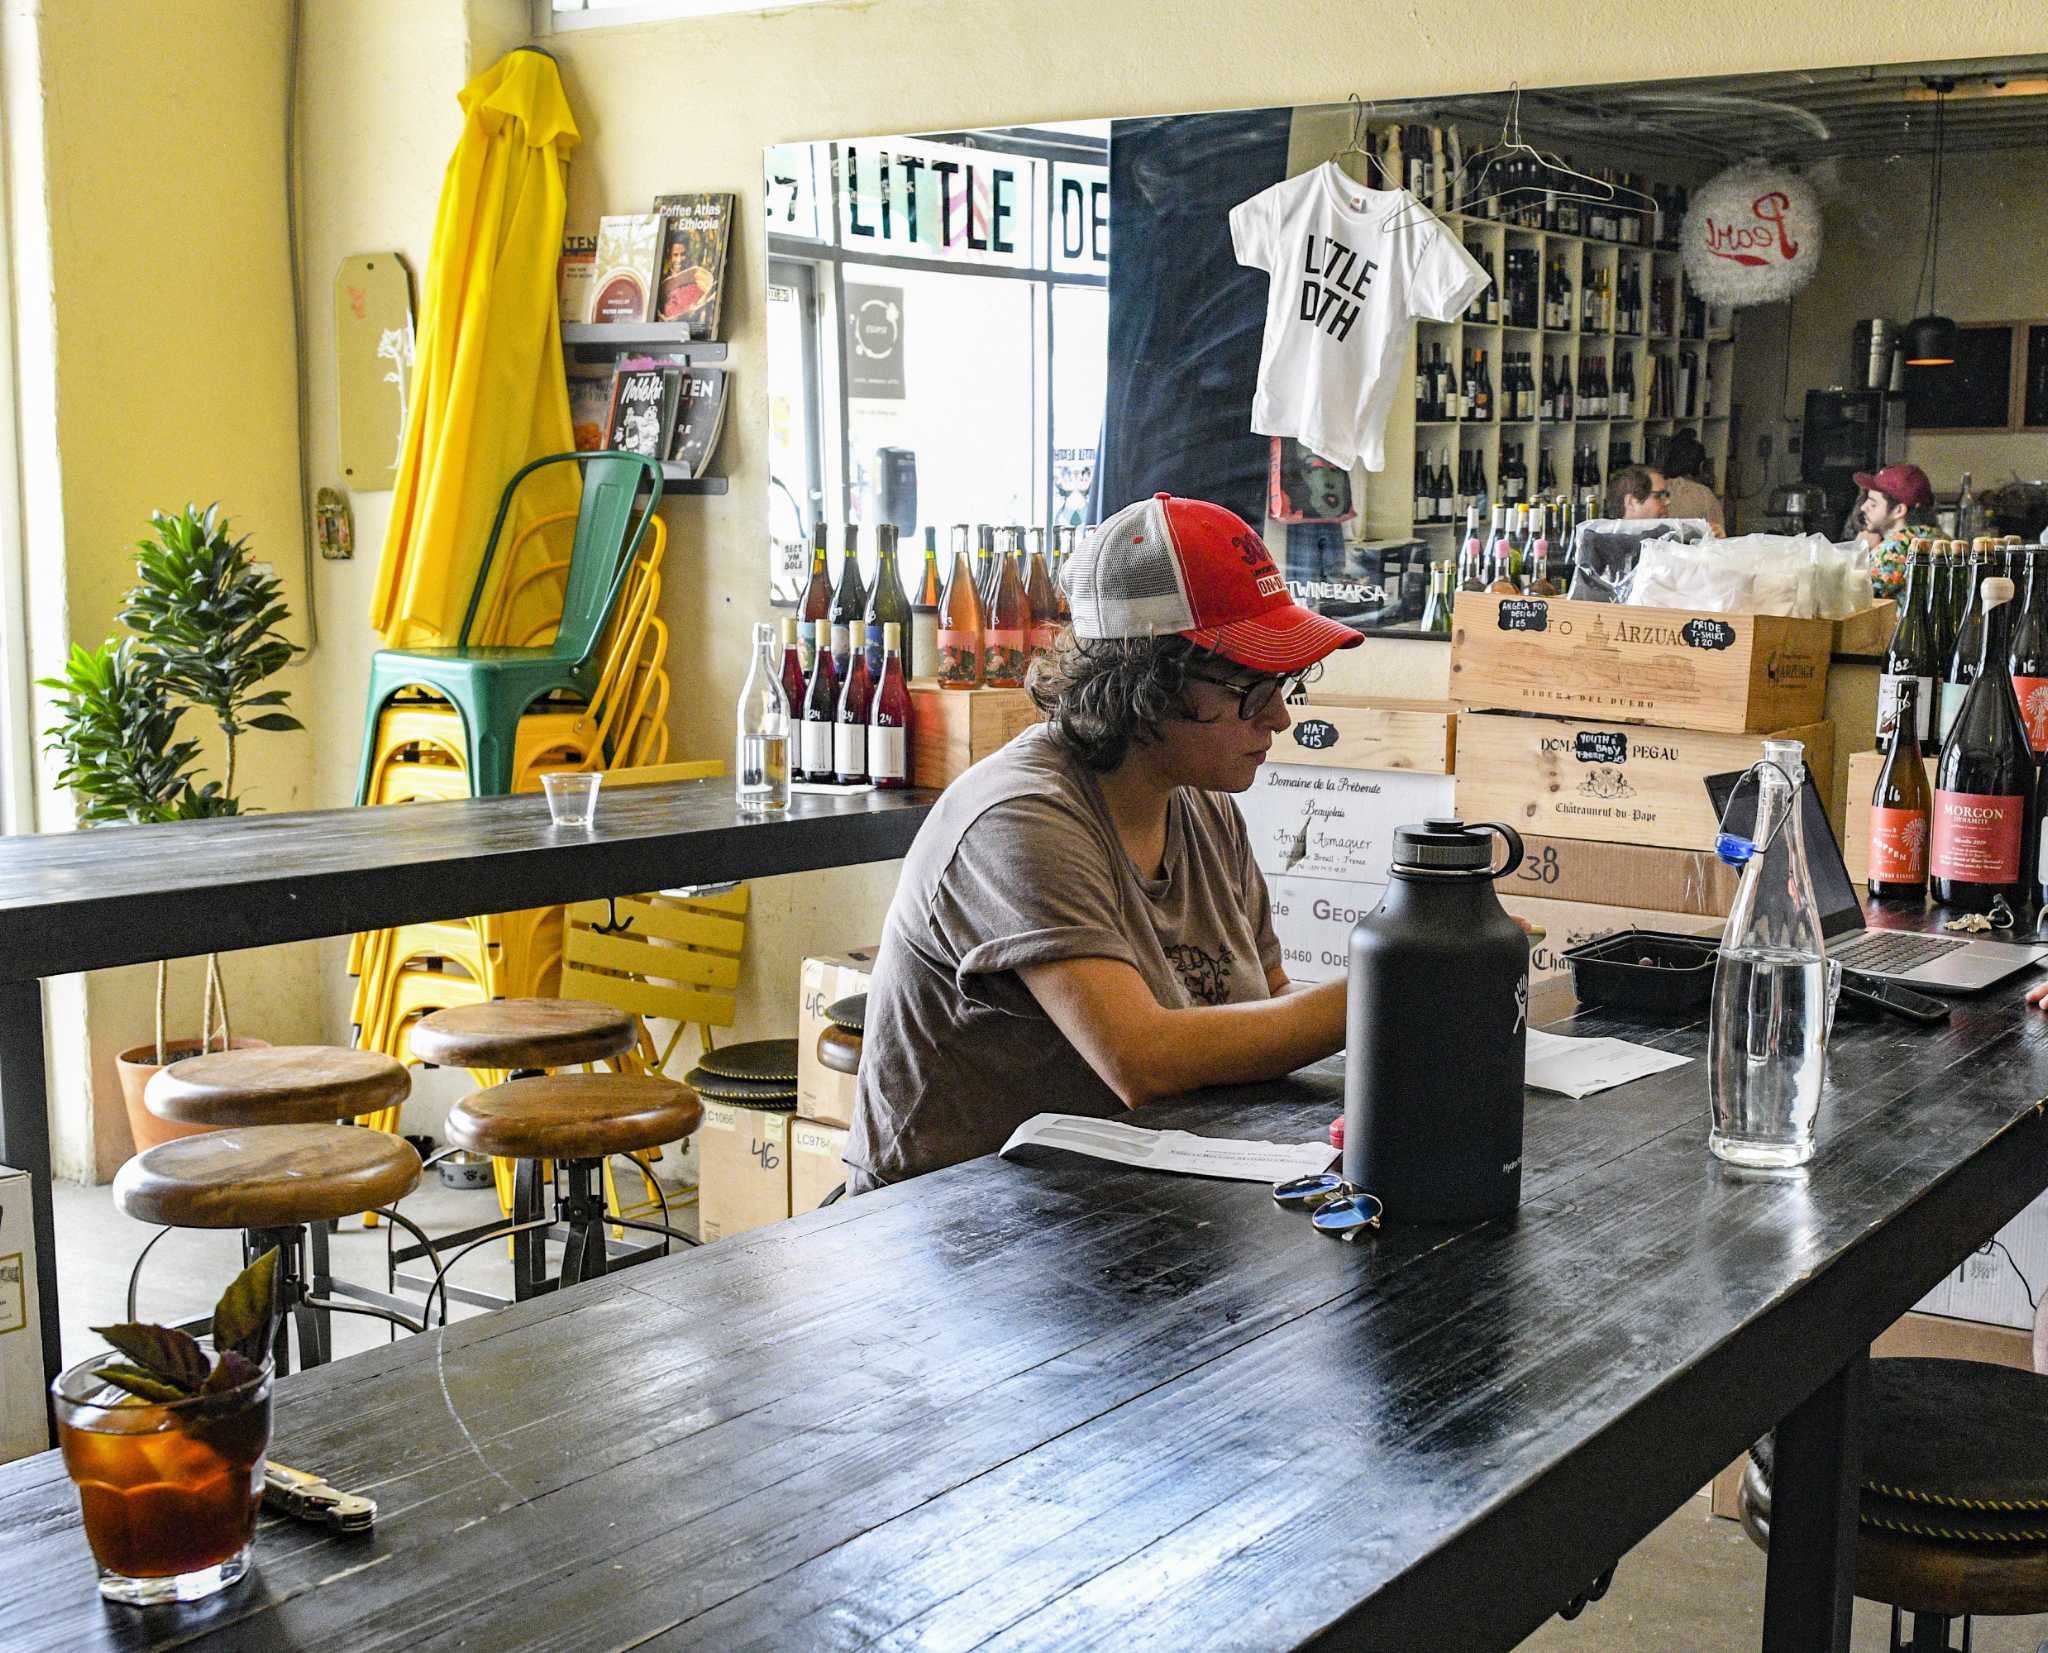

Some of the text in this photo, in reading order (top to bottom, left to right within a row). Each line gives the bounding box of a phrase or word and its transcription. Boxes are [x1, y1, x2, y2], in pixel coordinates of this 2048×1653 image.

[848, 146, 1014, 253] LITTLE
[659, 202, 721, 217] Coffee Atlas
[679, 217, 719, 232] Ethiopia
[1693, 620, 1721, 633] PRIDE
[1690, 629, 1725, 642] T-SHIRT
[1522, 688, 1654, 709] RIBERA DEL DUERO
[879, 713, 892, 725] 24
[1303, 724, 1329, 735] HAT
[1580, 734, 1610, 744] YOUTH
[1596, 744, 1621, 756] BABY
[1632, 745, 1679, 760] PEGAU
[1268, 772, 1312, 788] Domaine
[1313, 778, 1324, 789] de
[1326, 782, 1336, 791] la
[1301, 799, 1345, 822] Beaujolais
[1944, 804, 2003, 819] MORGON
[1517, 846, 1560, 884] 38
[1271, 901, 1289, 916] de
[1281, 947, 1312, 963] 9460
[805, 992, 826, 1021] 46
[752, 1137, 780, 1170] 46
